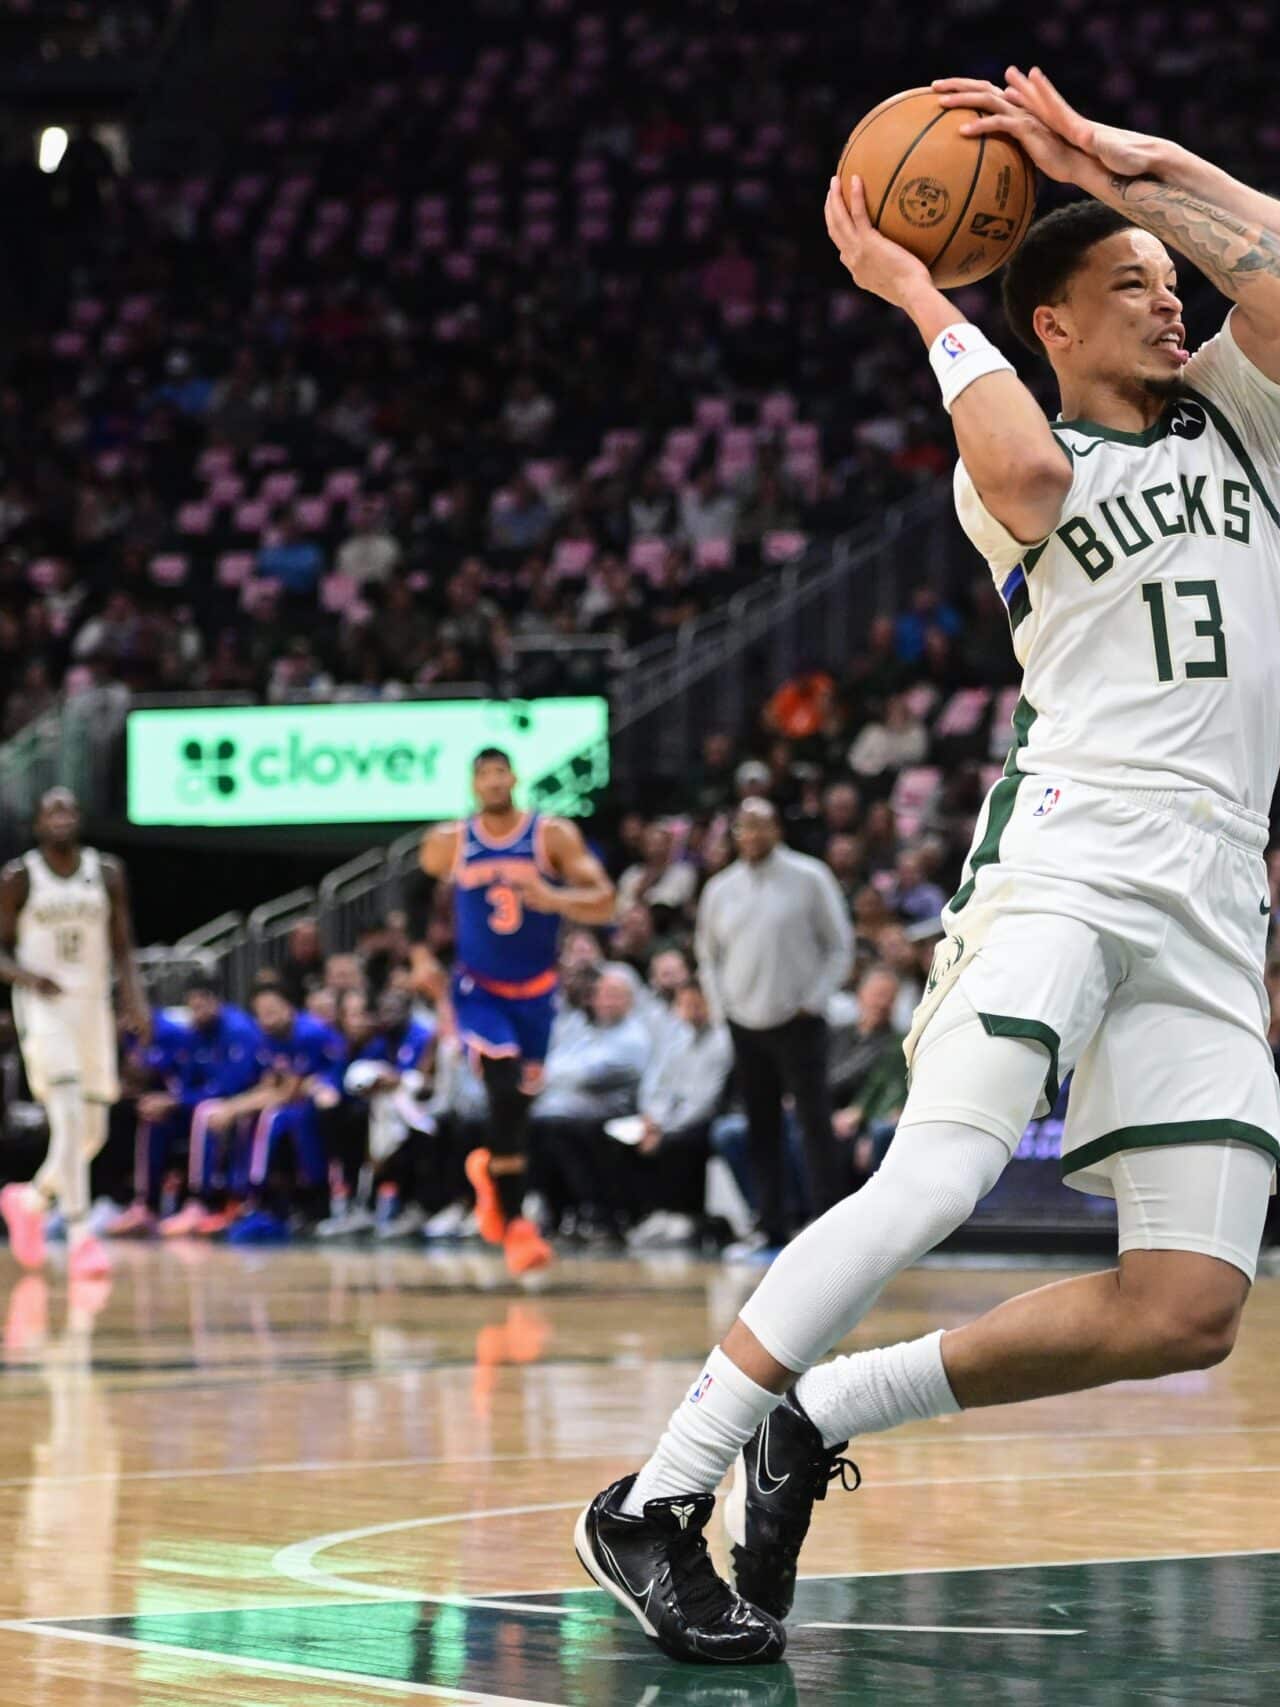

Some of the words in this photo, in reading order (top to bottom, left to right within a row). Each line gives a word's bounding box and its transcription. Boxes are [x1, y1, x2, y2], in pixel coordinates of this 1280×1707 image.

[1055, 472, 1252, 582] BUCKS
[1140, 578, 1230, 683] 13
[249, 733, 442, 788] clover
[485, 885, 523, 935] 3
